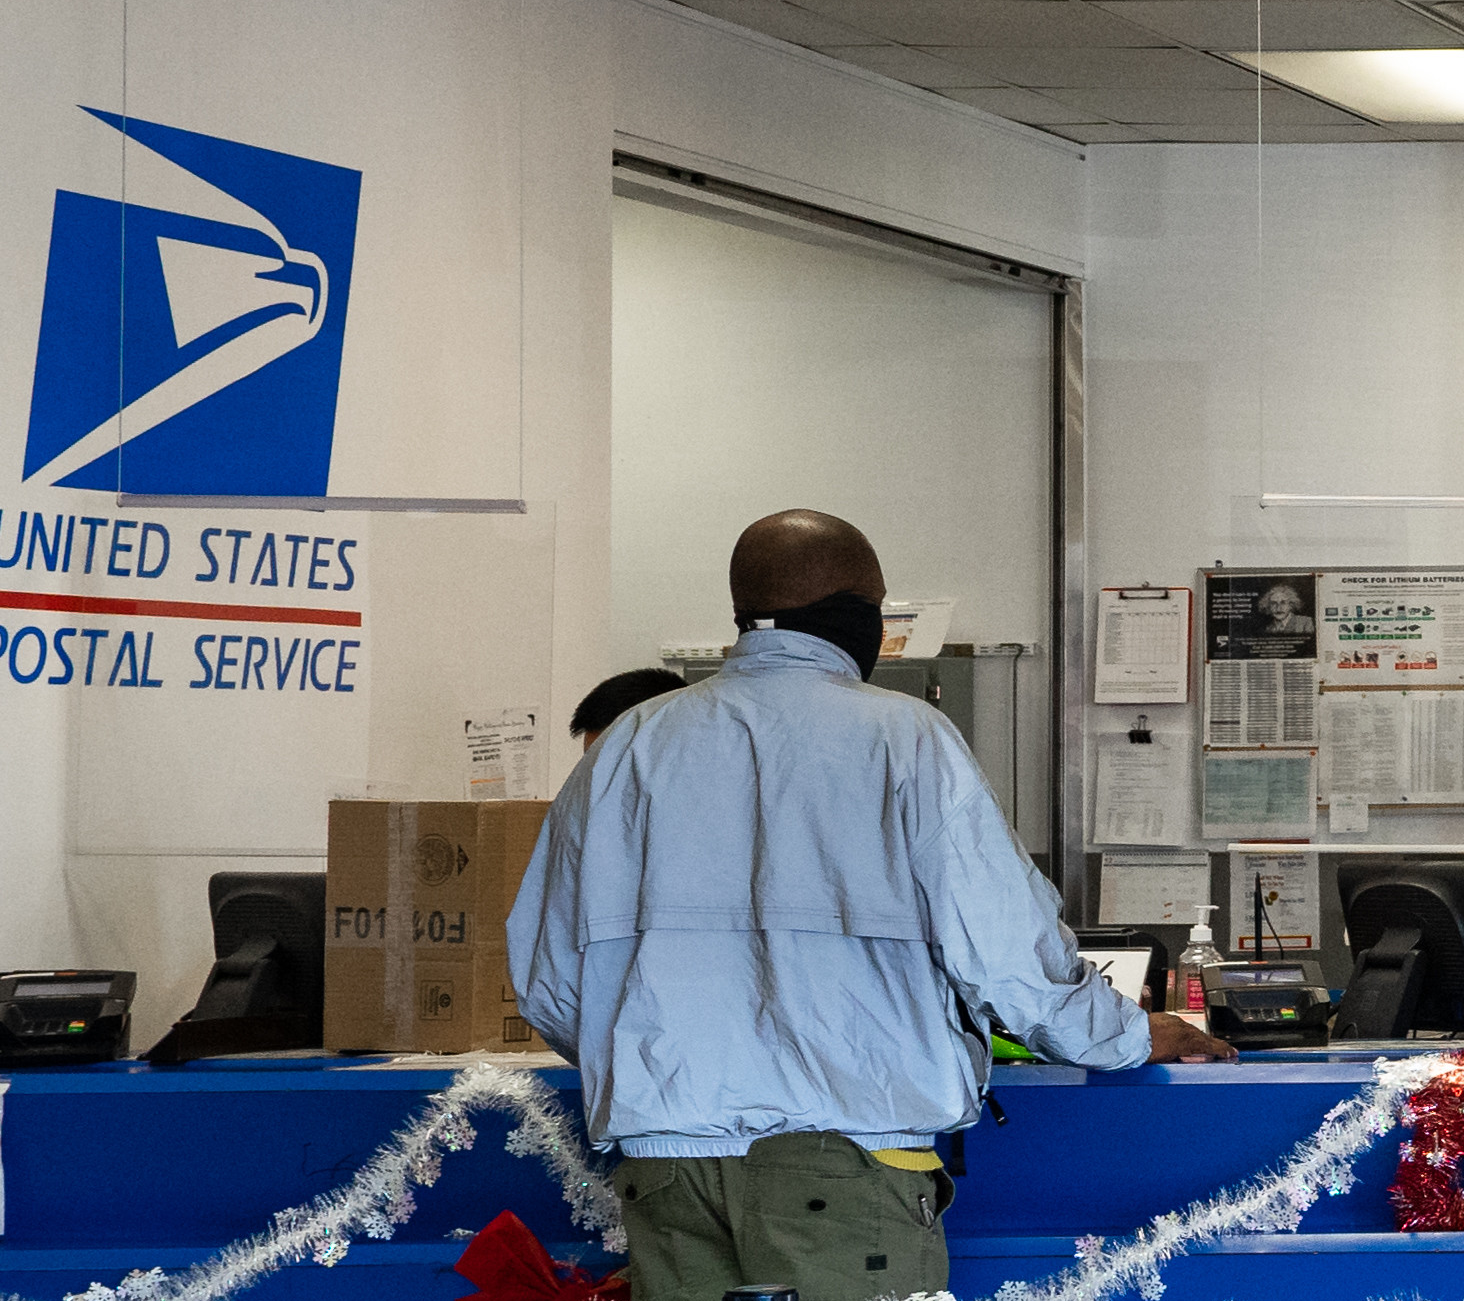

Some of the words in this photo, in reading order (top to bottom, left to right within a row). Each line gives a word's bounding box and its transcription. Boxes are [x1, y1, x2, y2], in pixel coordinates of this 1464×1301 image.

[0, 512, 170, 579] UNITED
[195, 527, 358, 592] STATES
[1341, 576, 1369, 585] CHECK
[1370, 576, 1387, 584] FOR
[1388, 576, 1421, 584] LITHIUM
[1422, 575, 1464, 583] BATTERIES
[0, 624, 164, 688] POSTAL
[189, 634, 361, 693] SERVICE
